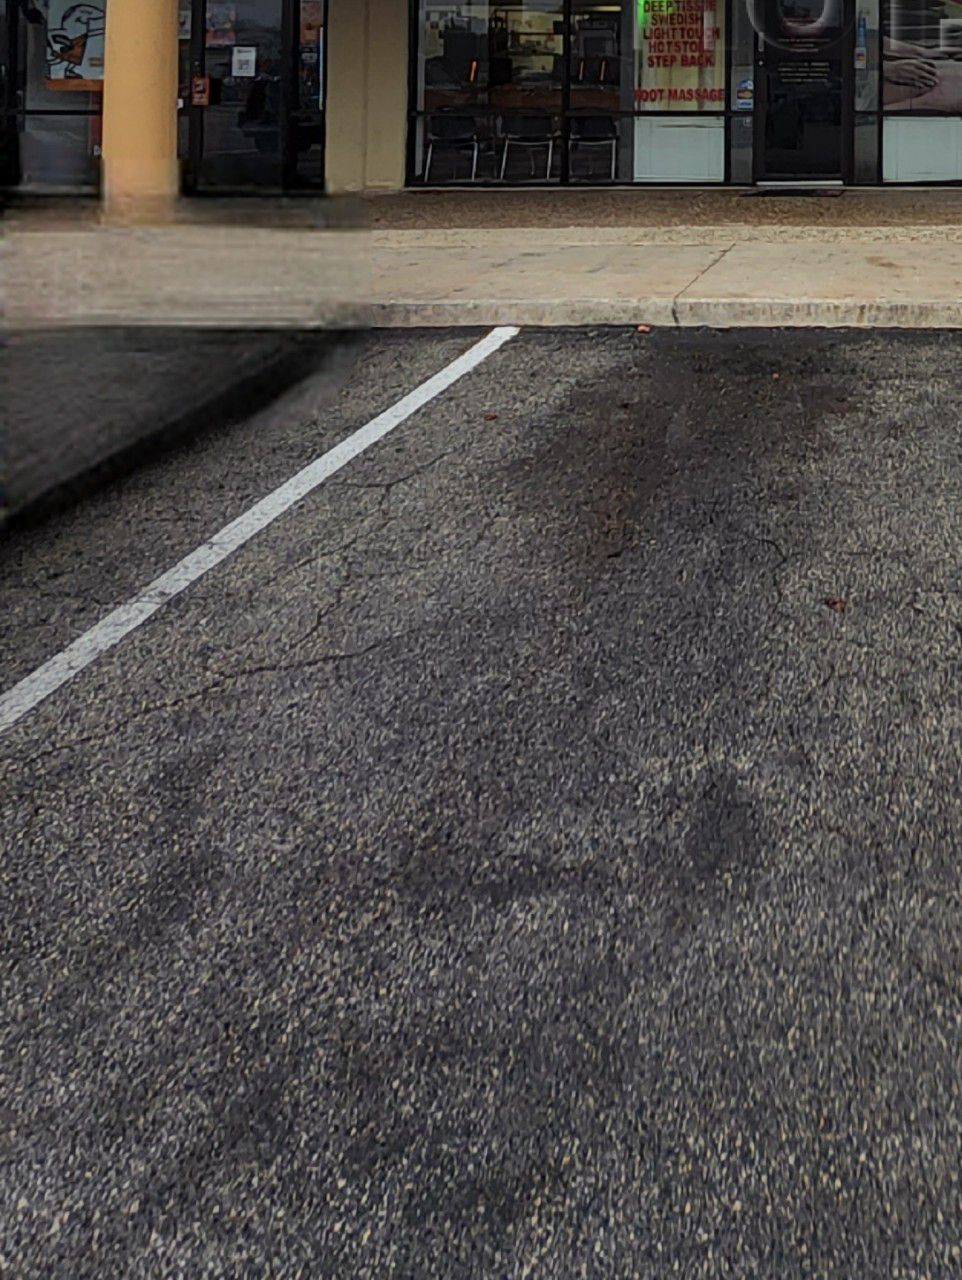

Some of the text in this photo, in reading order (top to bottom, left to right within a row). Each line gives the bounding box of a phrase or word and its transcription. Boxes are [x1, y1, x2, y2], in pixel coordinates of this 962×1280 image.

[644, 0, 674, 13] DEEP
[651, 13, 704, 26] SWEDISH
[643, 27, 678, 40] LIGHT
[649, 40, 714, 54] HOT STO
[648, 55, 677, 68] STEP
[668, 87, 725, 102] MASSAGE
